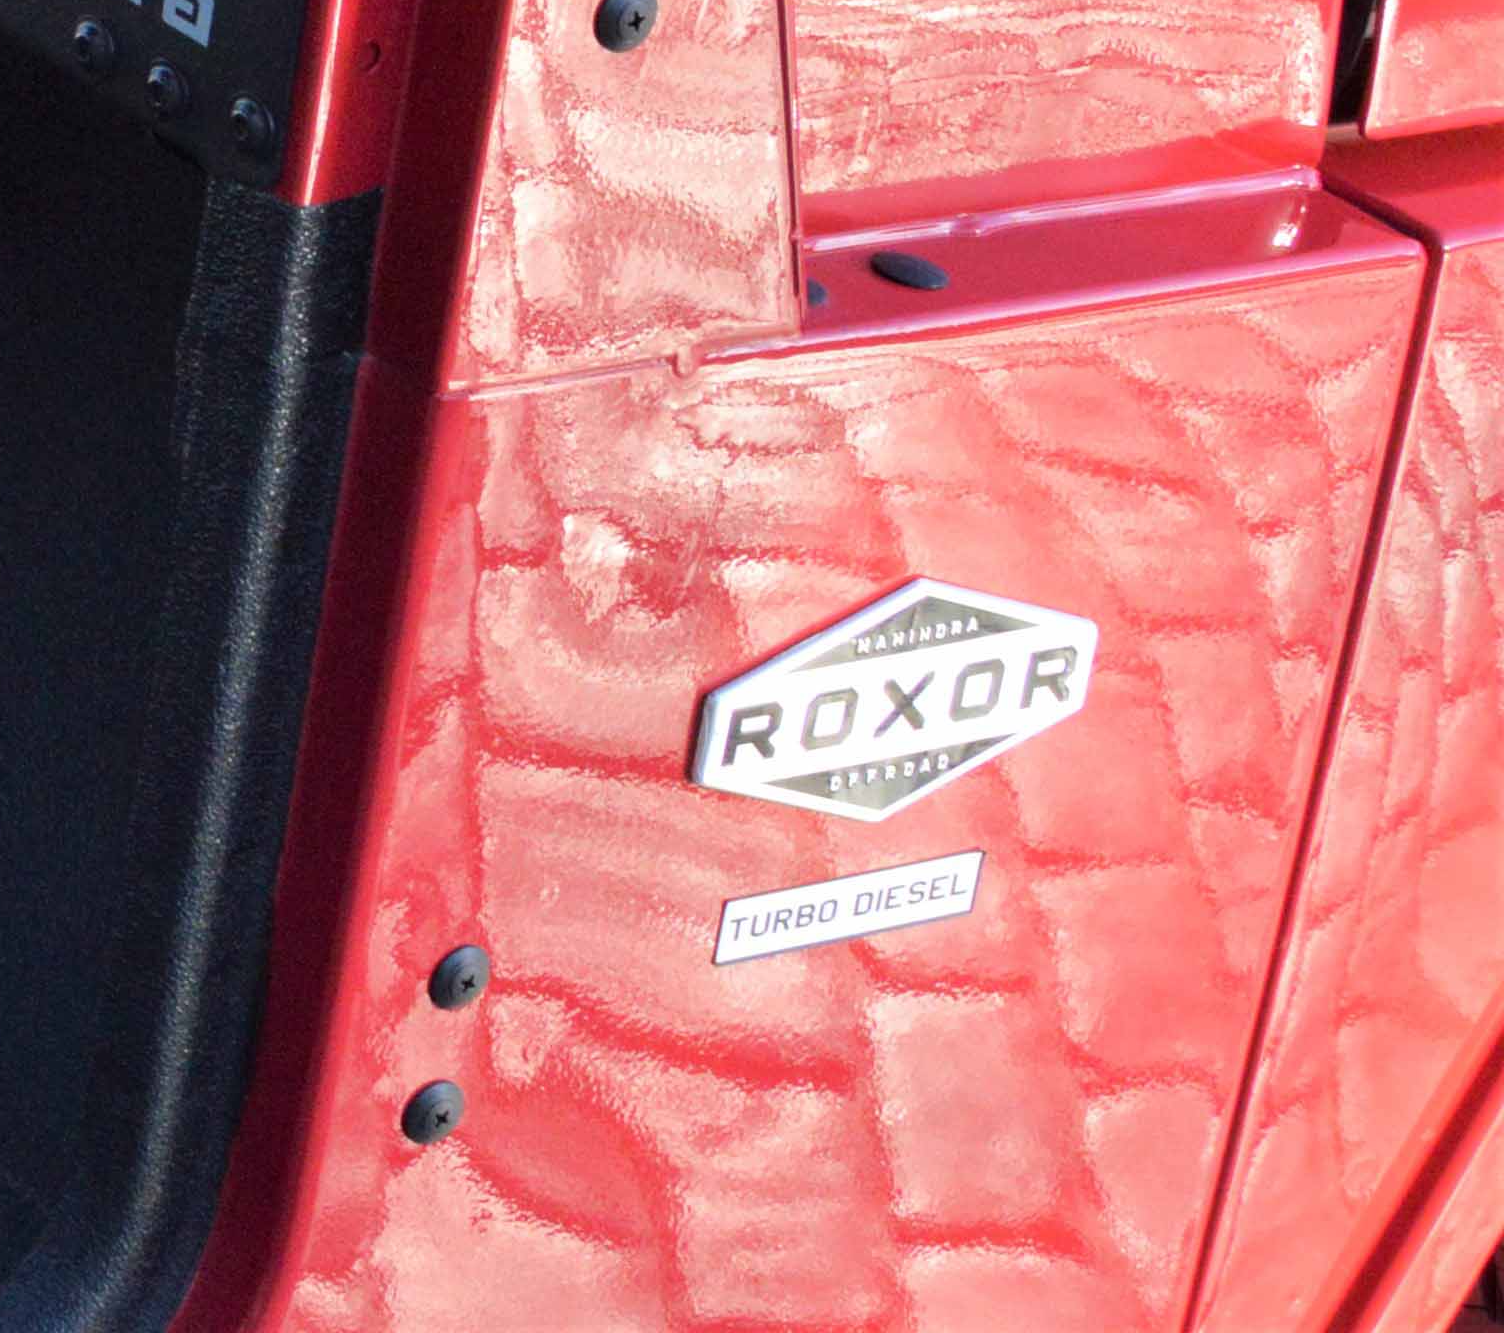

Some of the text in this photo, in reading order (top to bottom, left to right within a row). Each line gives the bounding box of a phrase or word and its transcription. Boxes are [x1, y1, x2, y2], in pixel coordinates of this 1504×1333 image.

[854, 617, 979, 654] MAHINDRA
[721, 646, 1078, 767] ROXOR
[827, 753, 950, 792] OFFROAD
[730, 873, 967, 942] TURBO DIESEL
